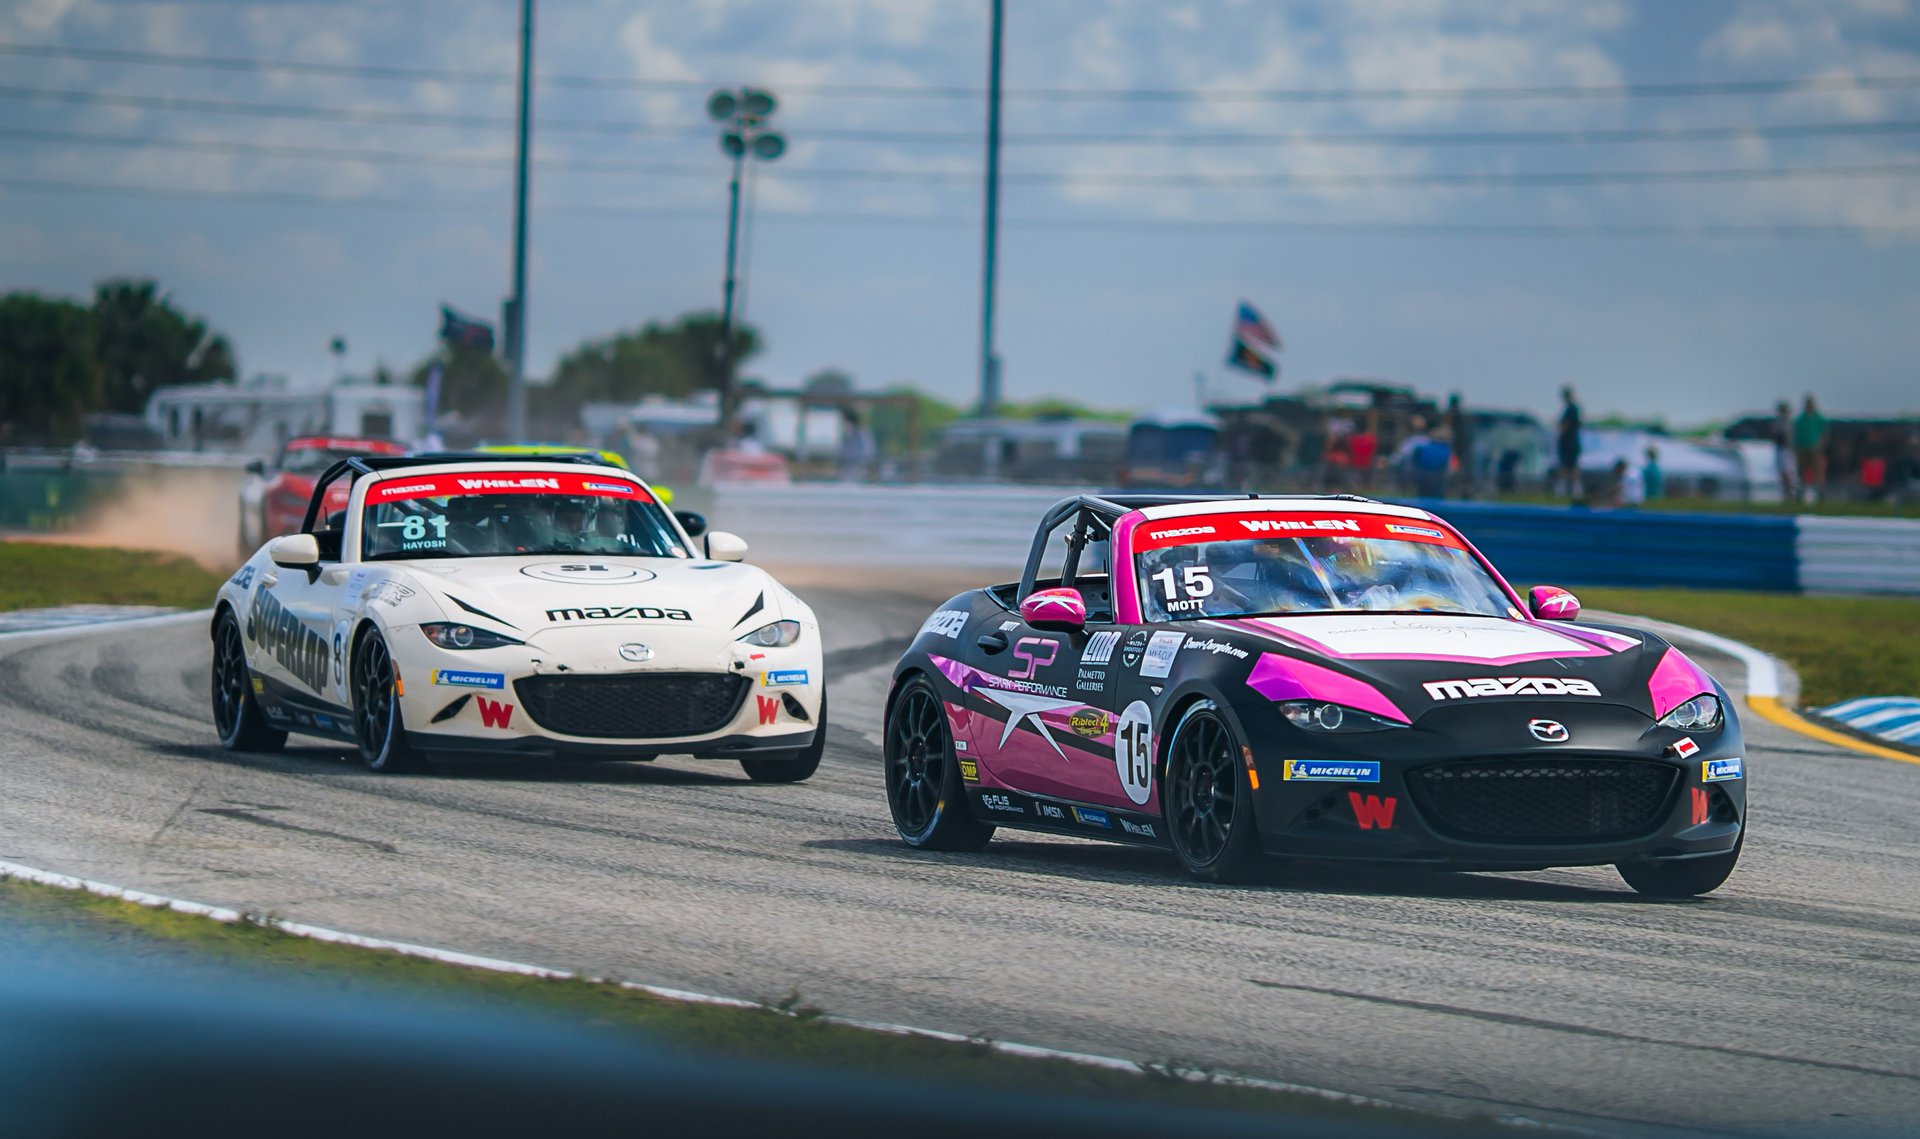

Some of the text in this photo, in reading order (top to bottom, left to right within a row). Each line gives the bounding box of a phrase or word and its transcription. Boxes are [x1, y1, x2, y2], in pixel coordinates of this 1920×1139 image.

[381, 484, 436, 496] mazda
[457, 478, 559, 490] WHELEN
[402, 514, 447, 540] 81
[1150, 526, 1216, 540] mazda
[1239, 520, 1361, 532] WHELEN
[402, 540, 446, 550] HAYOSH
[1152, 566, 1214, 600] 15
[545, 606, 694, 622] mazda
[1167, 599, 1205, 612] MOTT
[246, 583, 329, 697] SUPERLAP
[450, 675, 499, 686] MICHELIN
[988, 676, 1068, 698] SPARK PERFORMANCE
[1422, 677, 1602, 701] mazda
[476, 695, 514, 730] W
[756, 694, 780, 725] W
[1121, 720, 1149, 789] 15
[1309, 767, 1372, 777] MICHELIN
[1347, 791, 1397, 830] W
[1119, 817, 1157, 838] WHELEN
